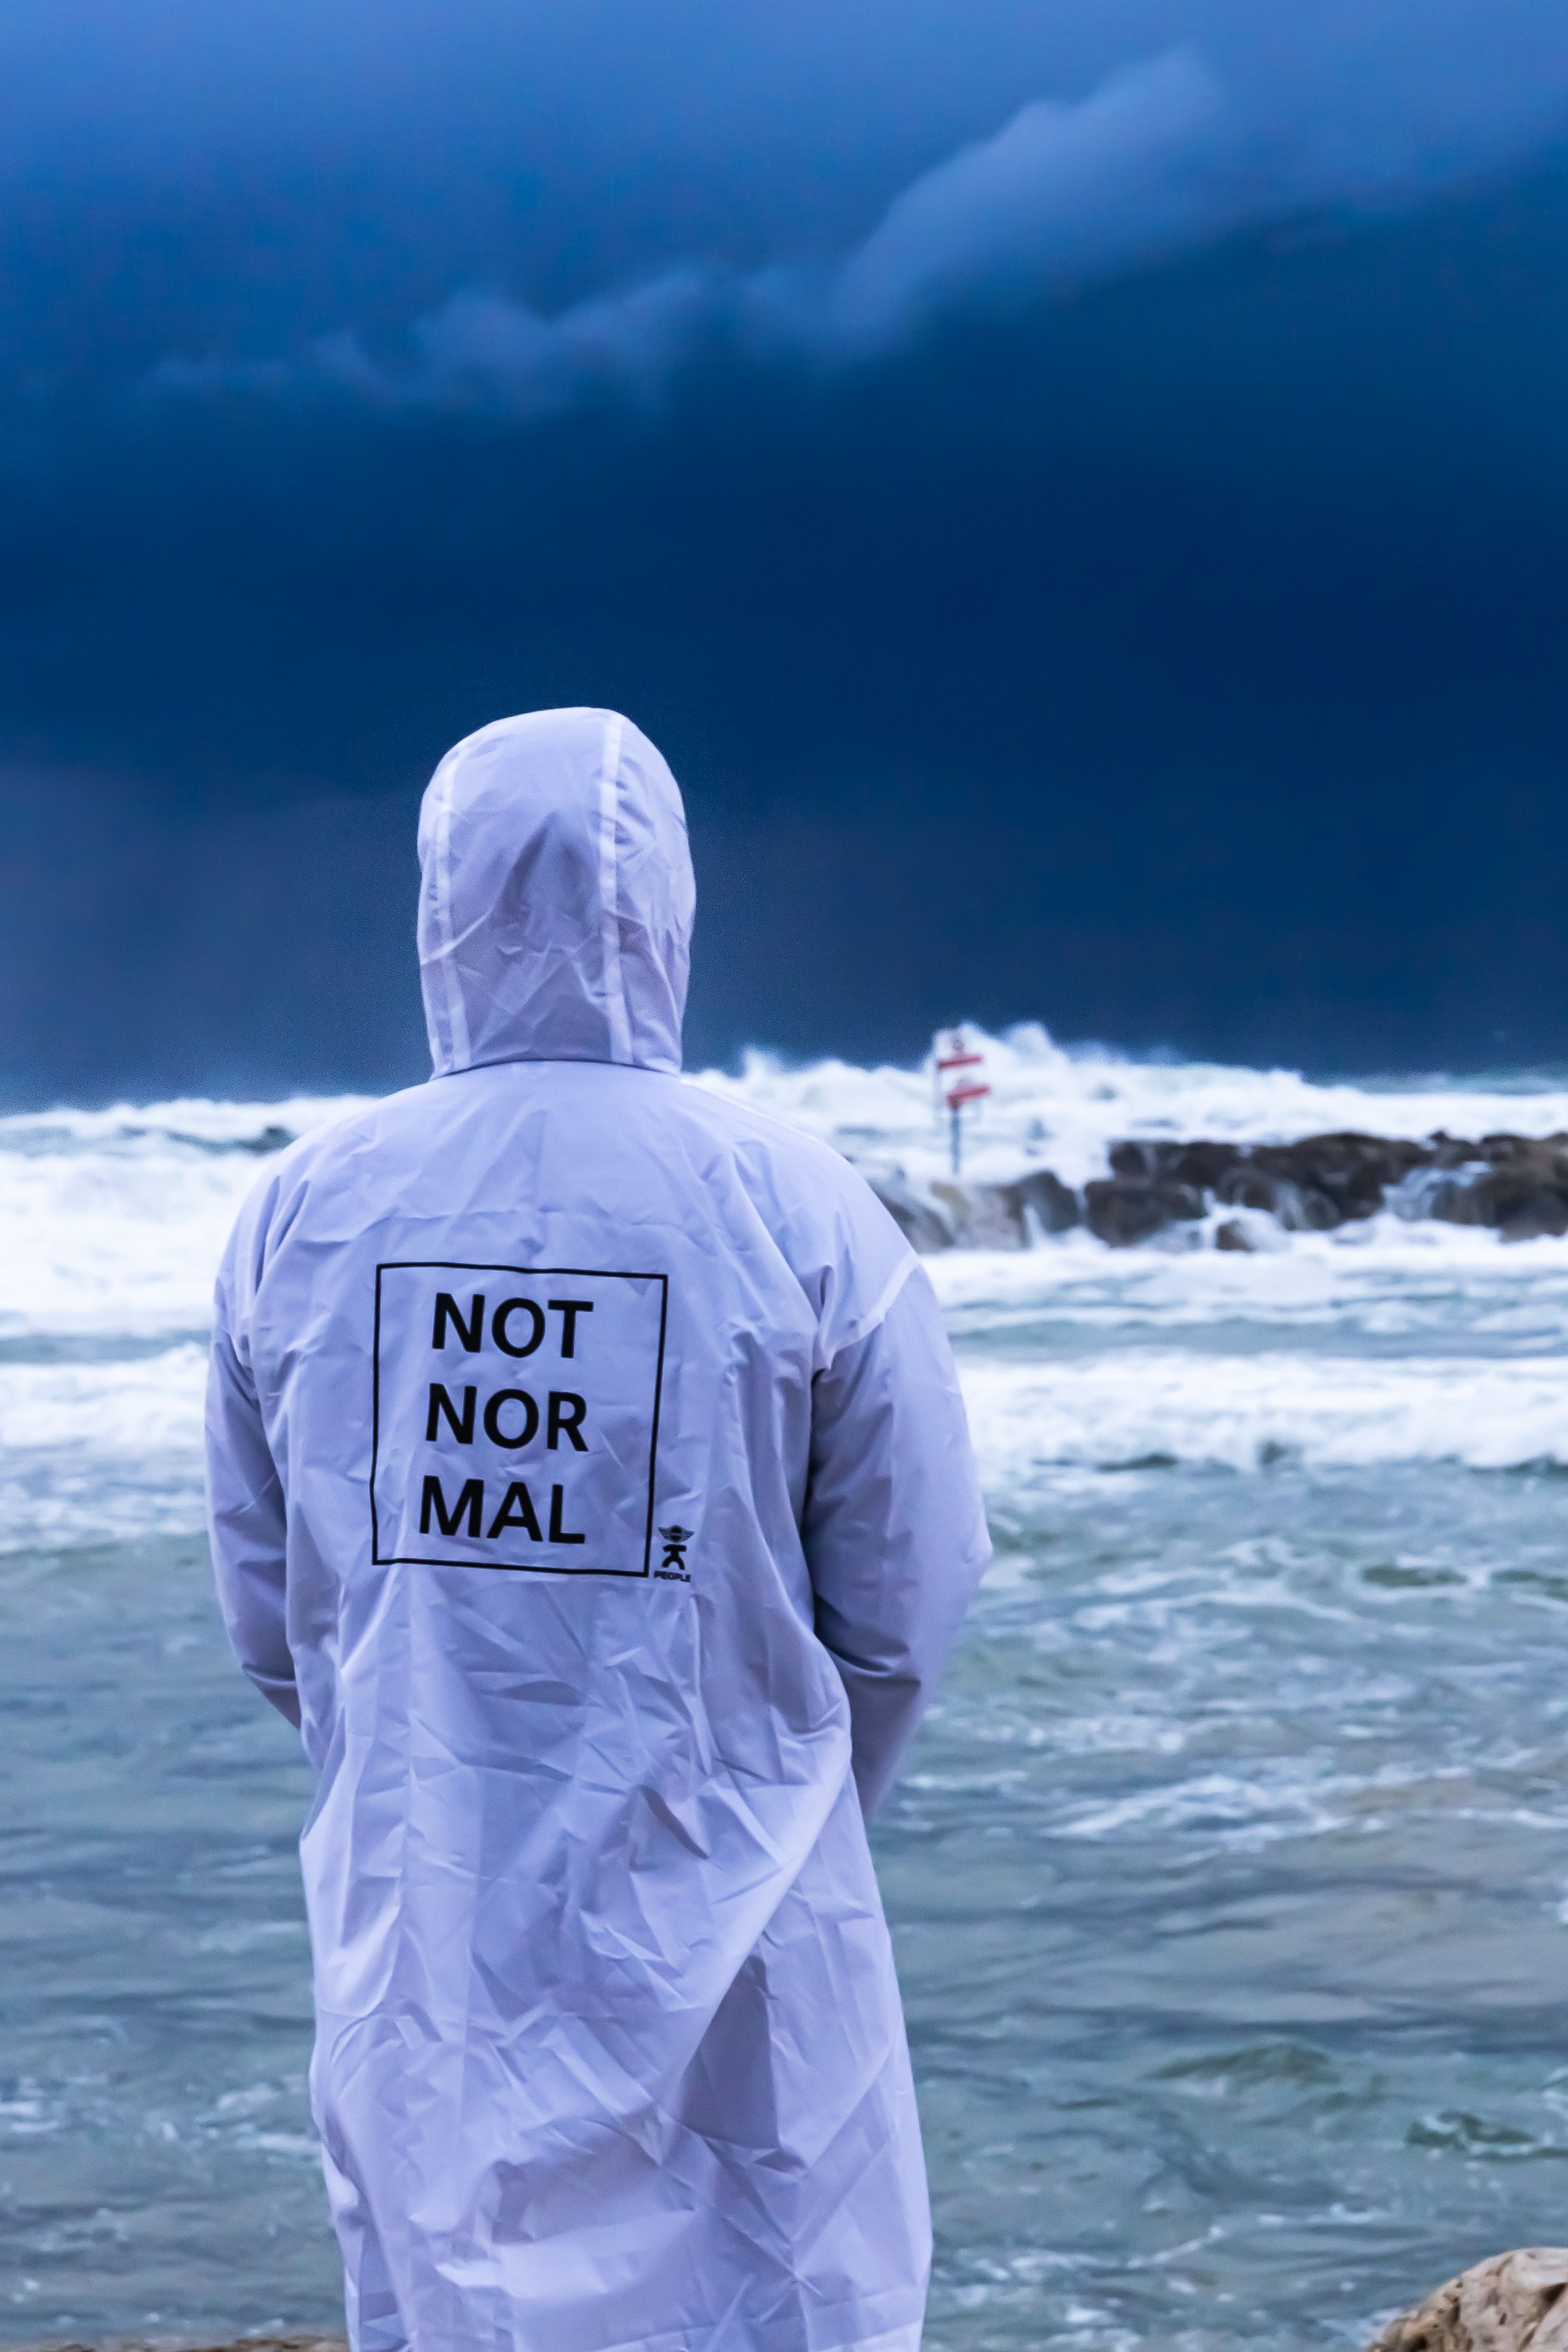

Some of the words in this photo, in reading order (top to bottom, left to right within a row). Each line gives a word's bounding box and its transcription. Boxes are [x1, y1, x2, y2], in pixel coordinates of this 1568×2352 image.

[432, 1292, 594, 1359] NOT
[425, 1383, 590, 1452] NOR
[419, 1474, 586, 1544] MAL
